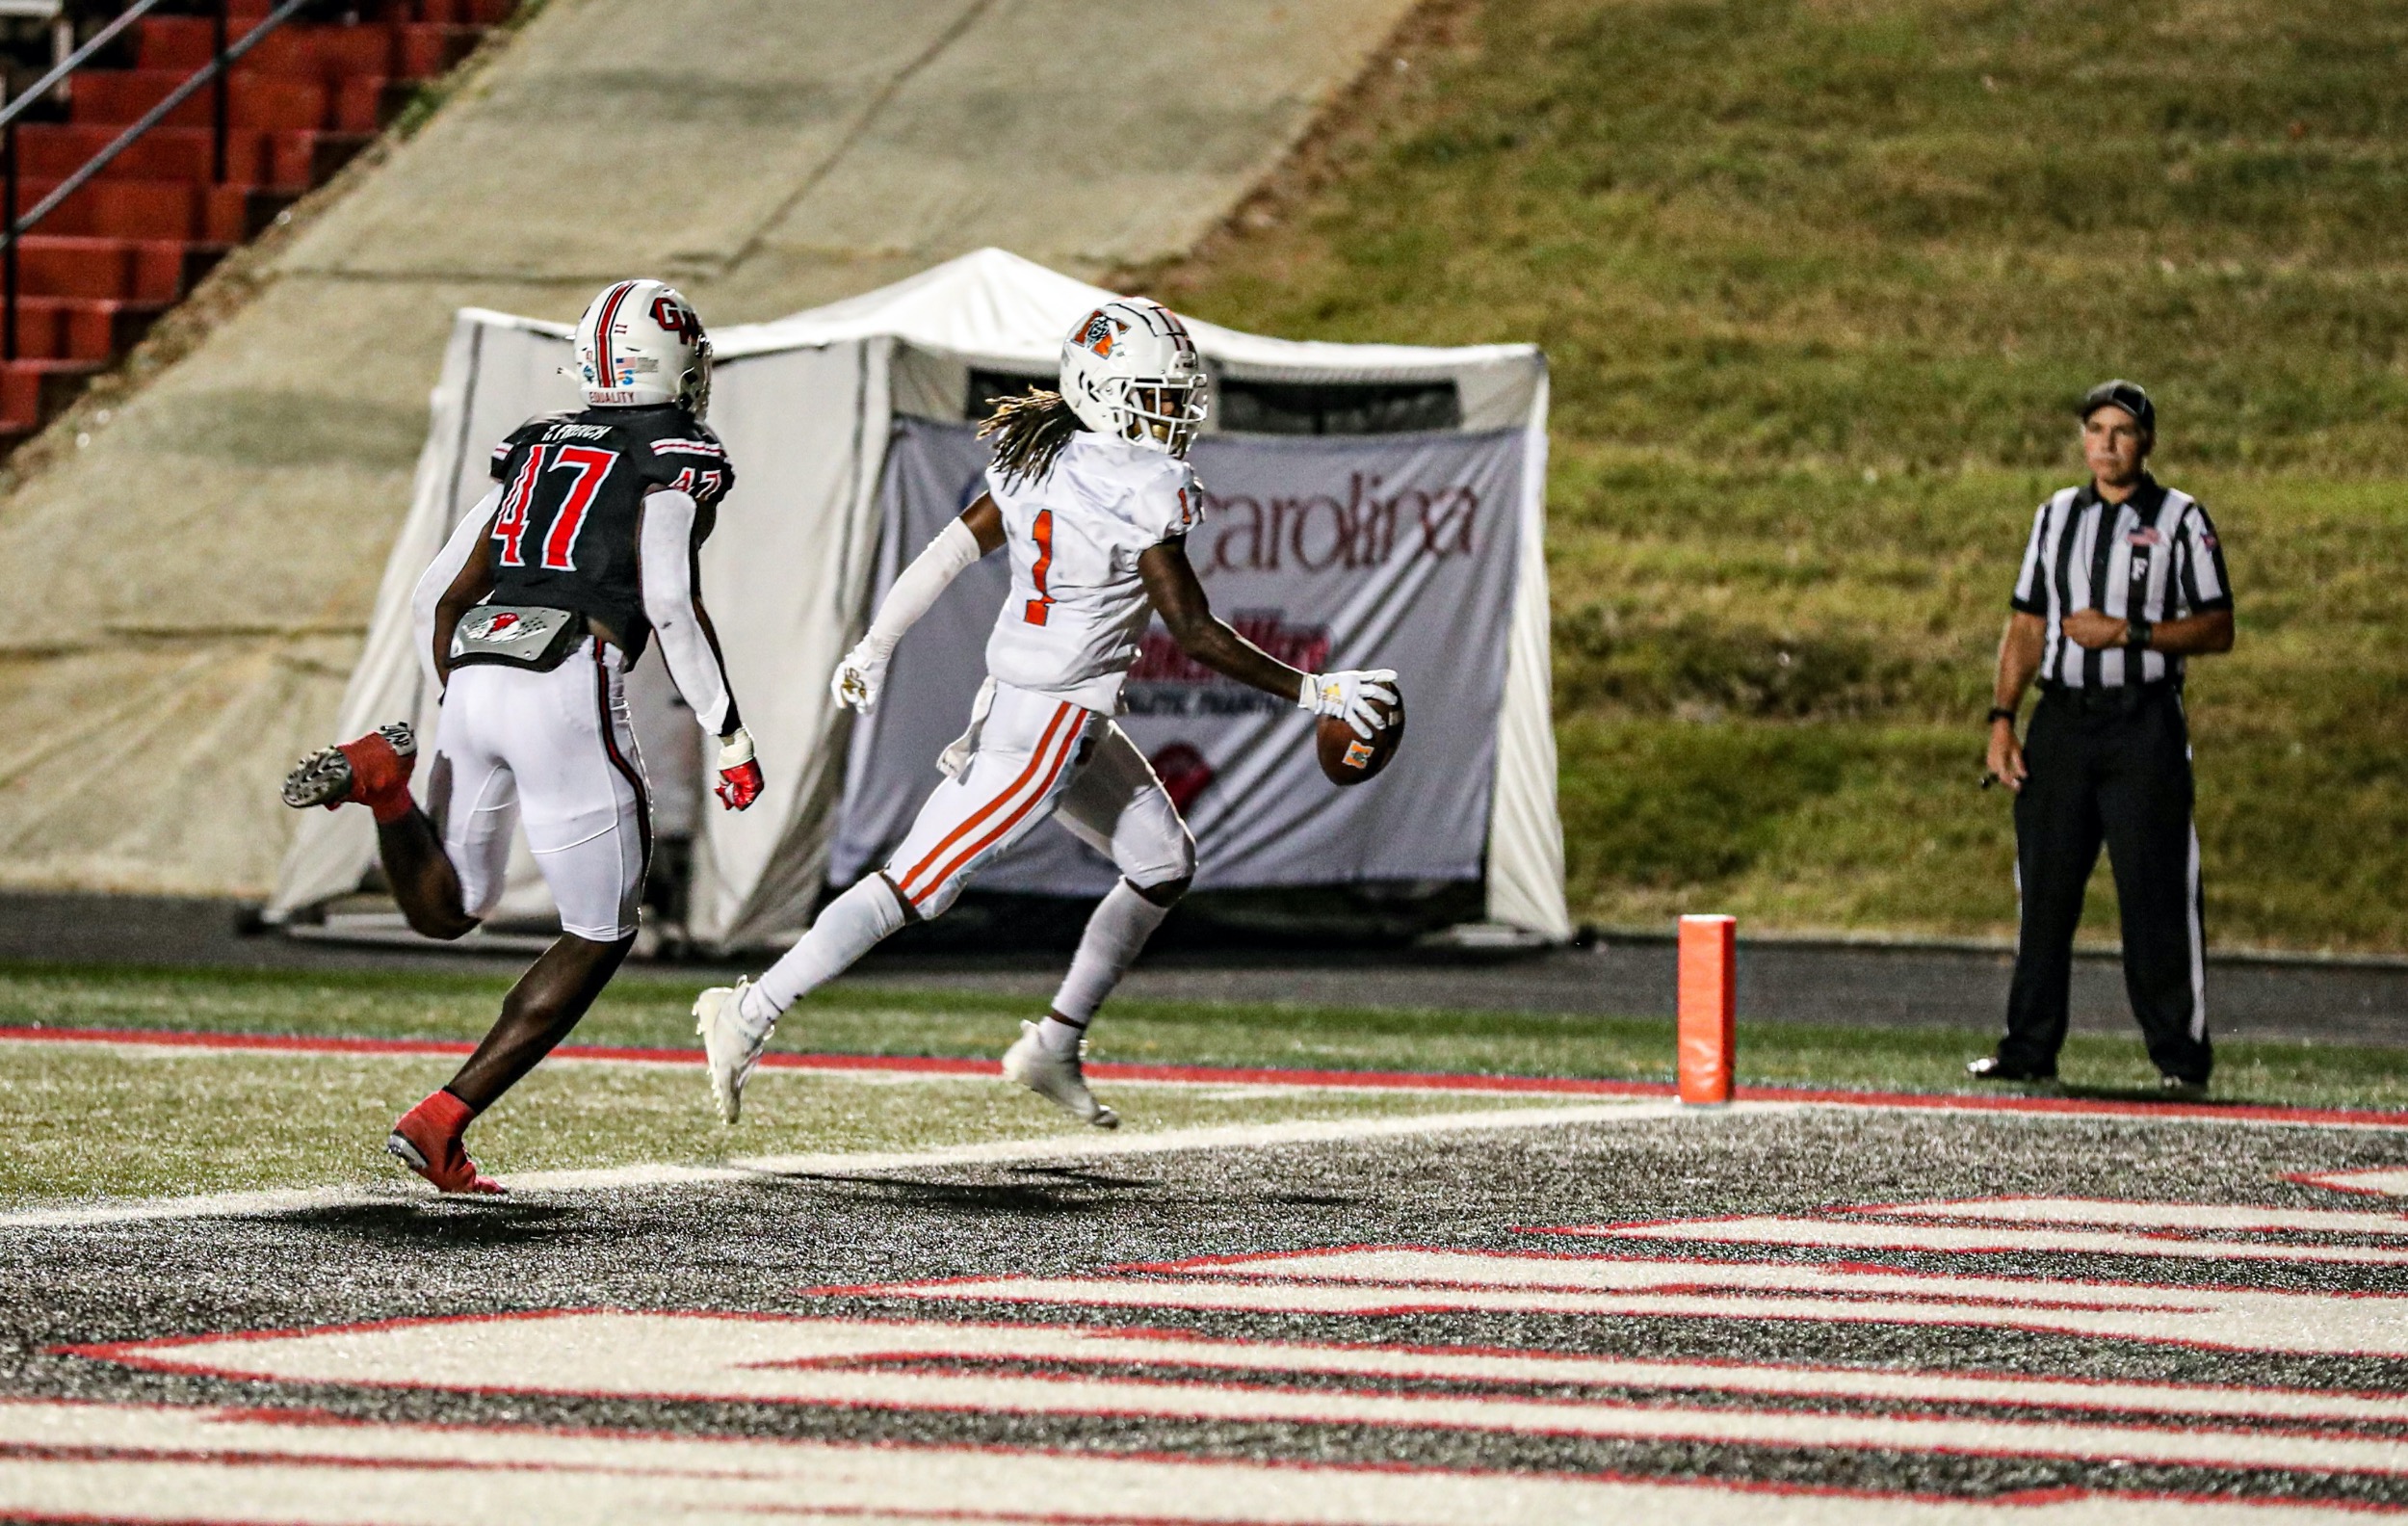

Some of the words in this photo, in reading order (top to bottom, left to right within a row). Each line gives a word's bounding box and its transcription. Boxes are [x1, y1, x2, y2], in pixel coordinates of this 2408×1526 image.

[589, 391, 635, 404] EQUALITY
[667, 467, 721, 501] 47
[491, 444, 619, 572] 47
[1178, 487, 1191, 524] 1
[1023, 509, 1057, 626] 1
